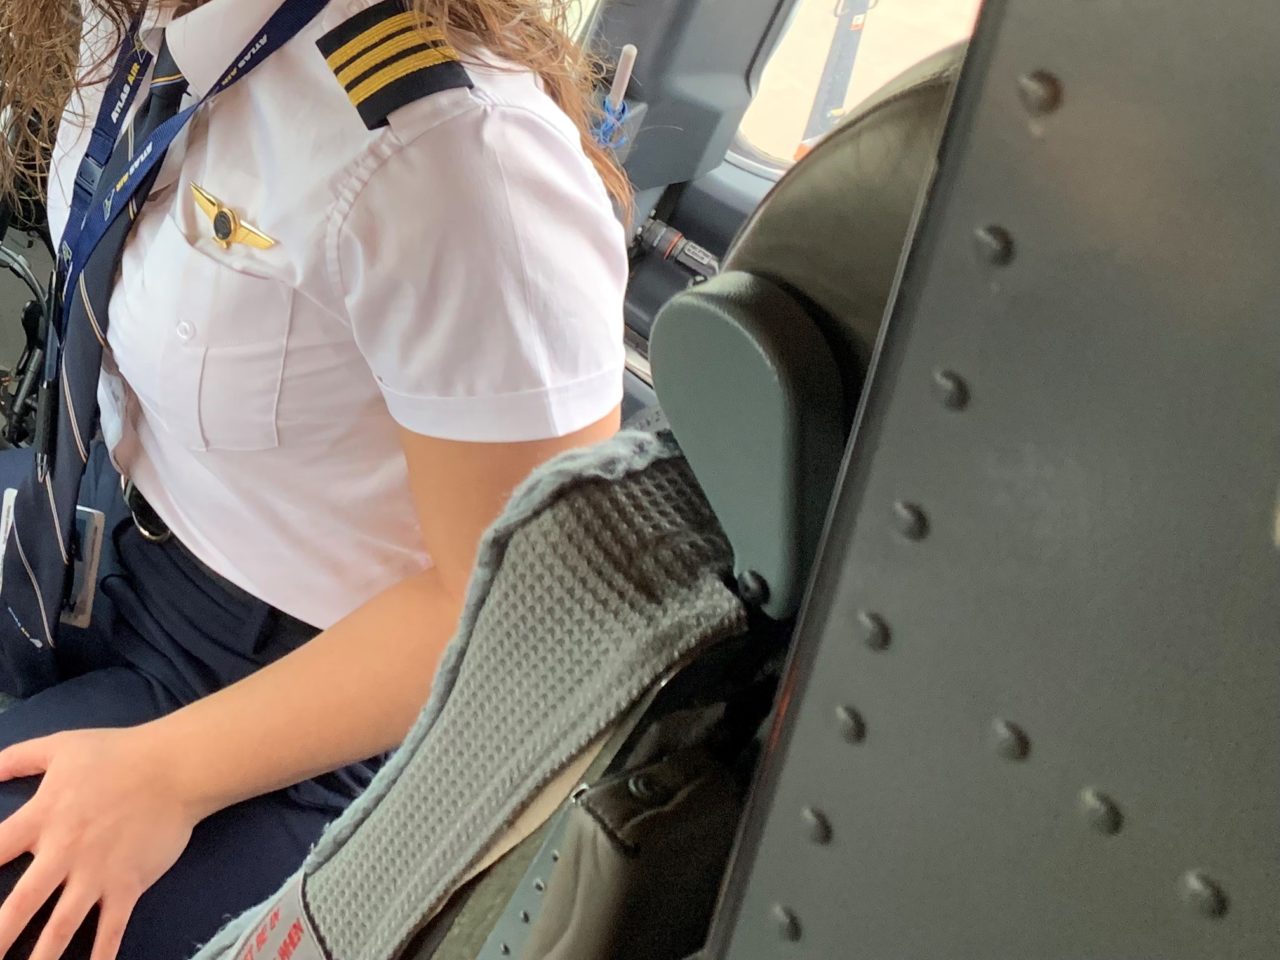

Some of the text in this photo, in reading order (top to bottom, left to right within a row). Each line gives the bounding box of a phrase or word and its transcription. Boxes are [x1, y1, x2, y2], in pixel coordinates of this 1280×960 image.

[238, 34, 268, 69] ATLAS
[110, 62, 140, 124] ATLAS AIR
[128, 141, 153, 176] ATLAS
